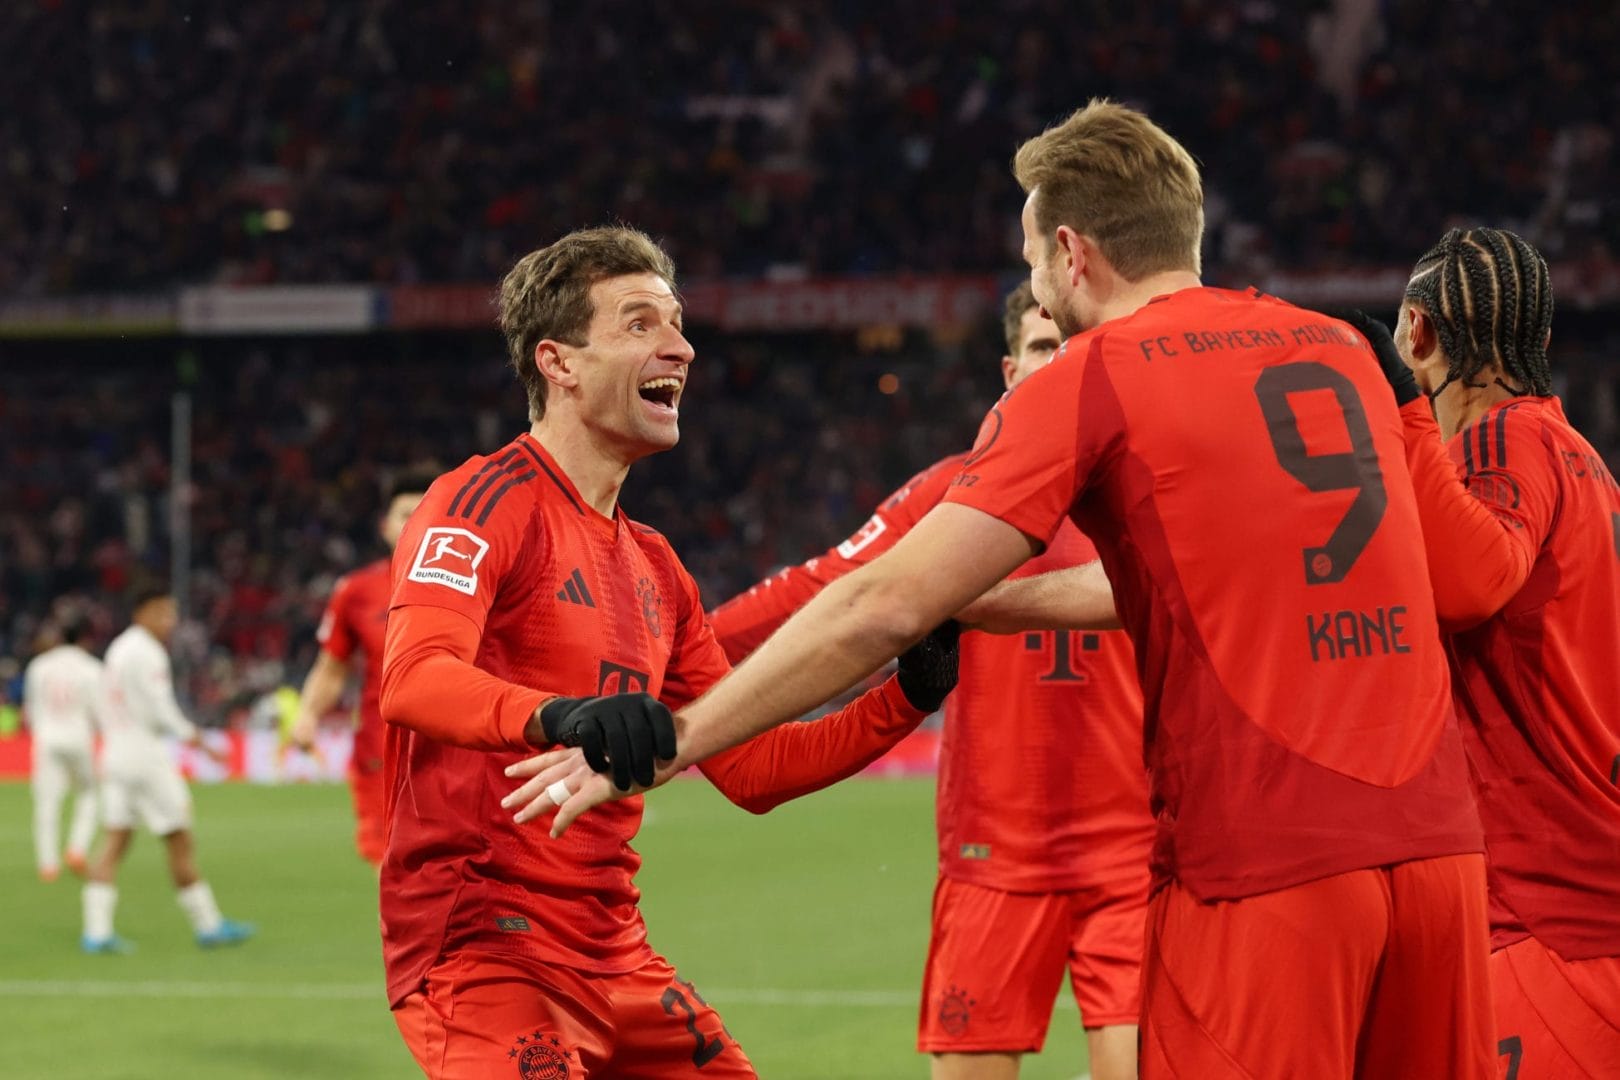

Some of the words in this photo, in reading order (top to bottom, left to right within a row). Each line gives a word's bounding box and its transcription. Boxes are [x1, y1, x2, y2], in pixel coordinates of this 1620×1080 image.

[1139, 336, 1178, 362] FC
[1183, 328, 1286, 354] BAYERN
[1253, 360, 1388, 586] 9
[415, 571, 470, 589] BUNDESLIGA
[1305, 604, 1411, 663] KANE
